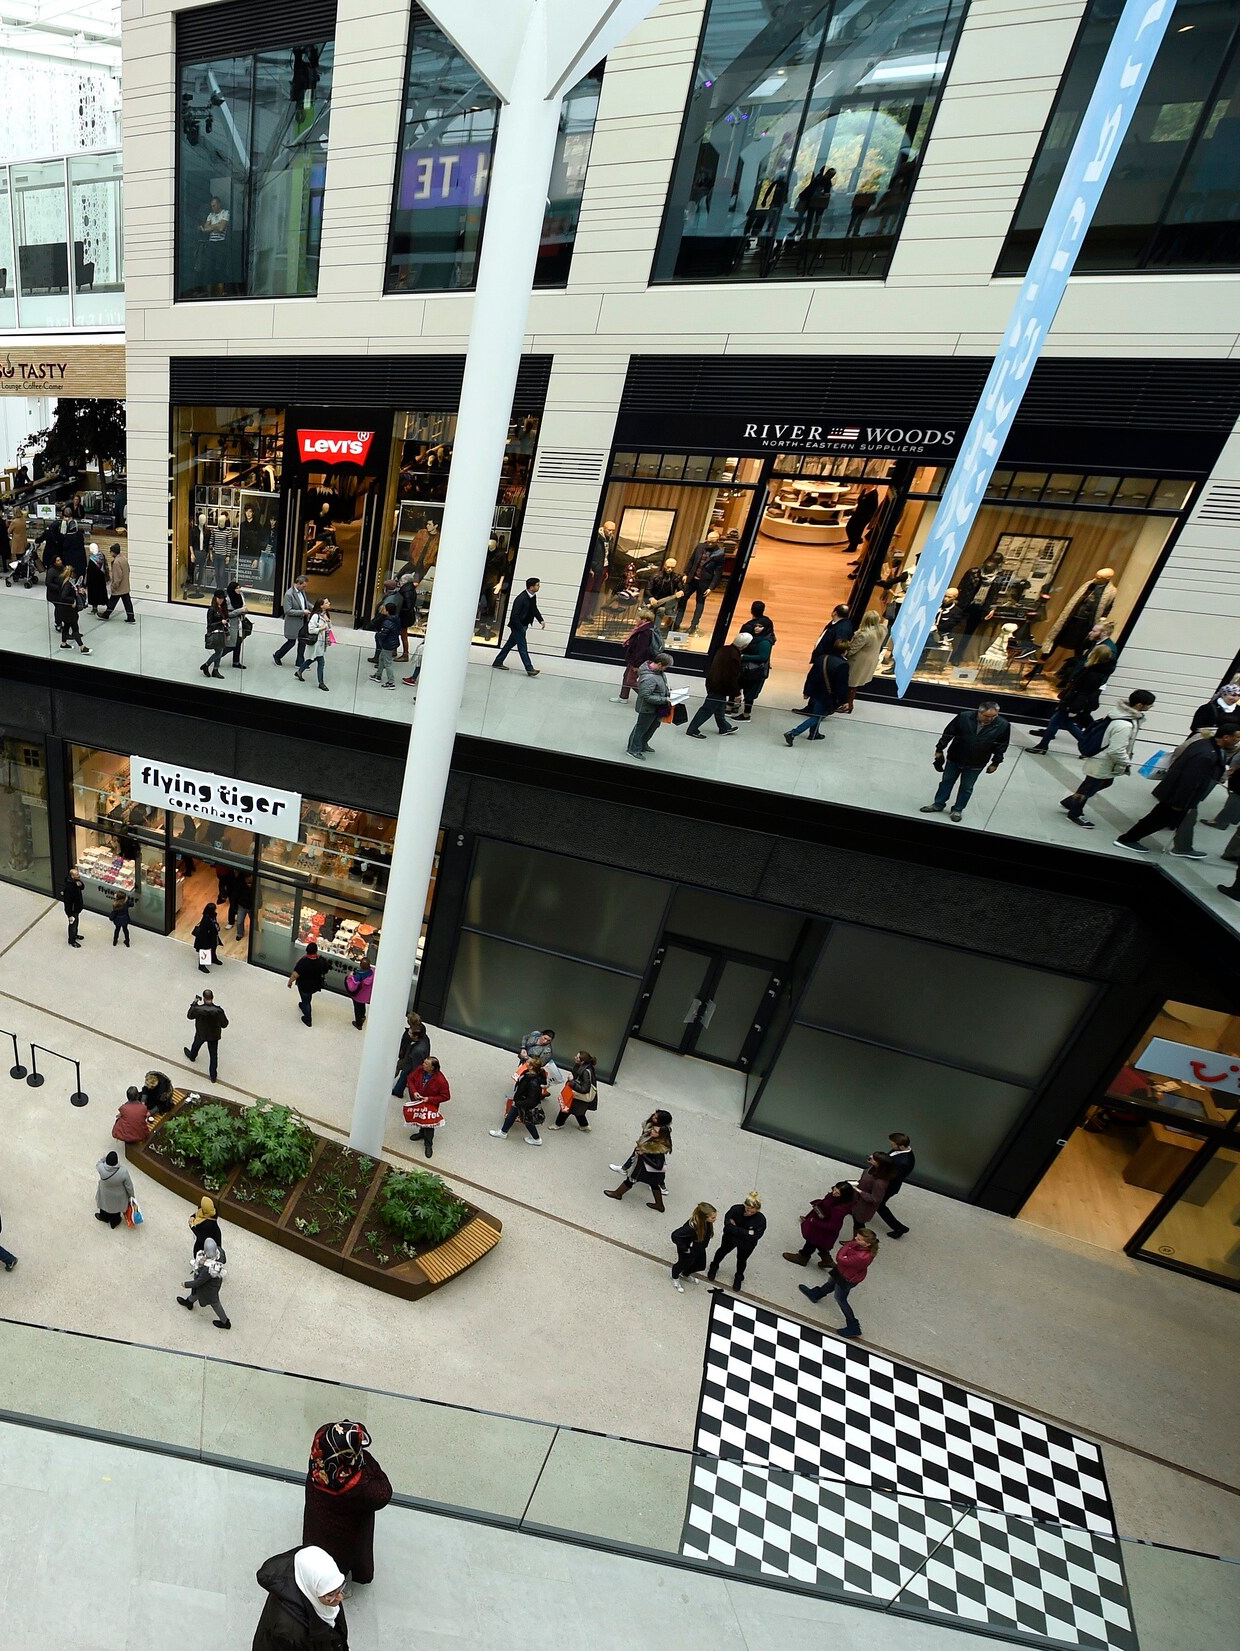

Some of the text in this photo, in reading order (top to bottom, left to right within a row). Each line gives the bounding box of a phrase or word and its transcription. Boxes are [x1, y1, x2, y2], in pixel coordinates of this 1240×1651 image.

[18, 363, 68, 379] TASTY
[1, 381, 21, 391] Lounge
[743, 423, 956, 446] RIVER WOODS
[762, 440, 924, 453] NORTH-EASTERN SUPPLIERS
[141, 766, 286, 817] flying tiger
[168, 797, 253, 825] copenhagen
